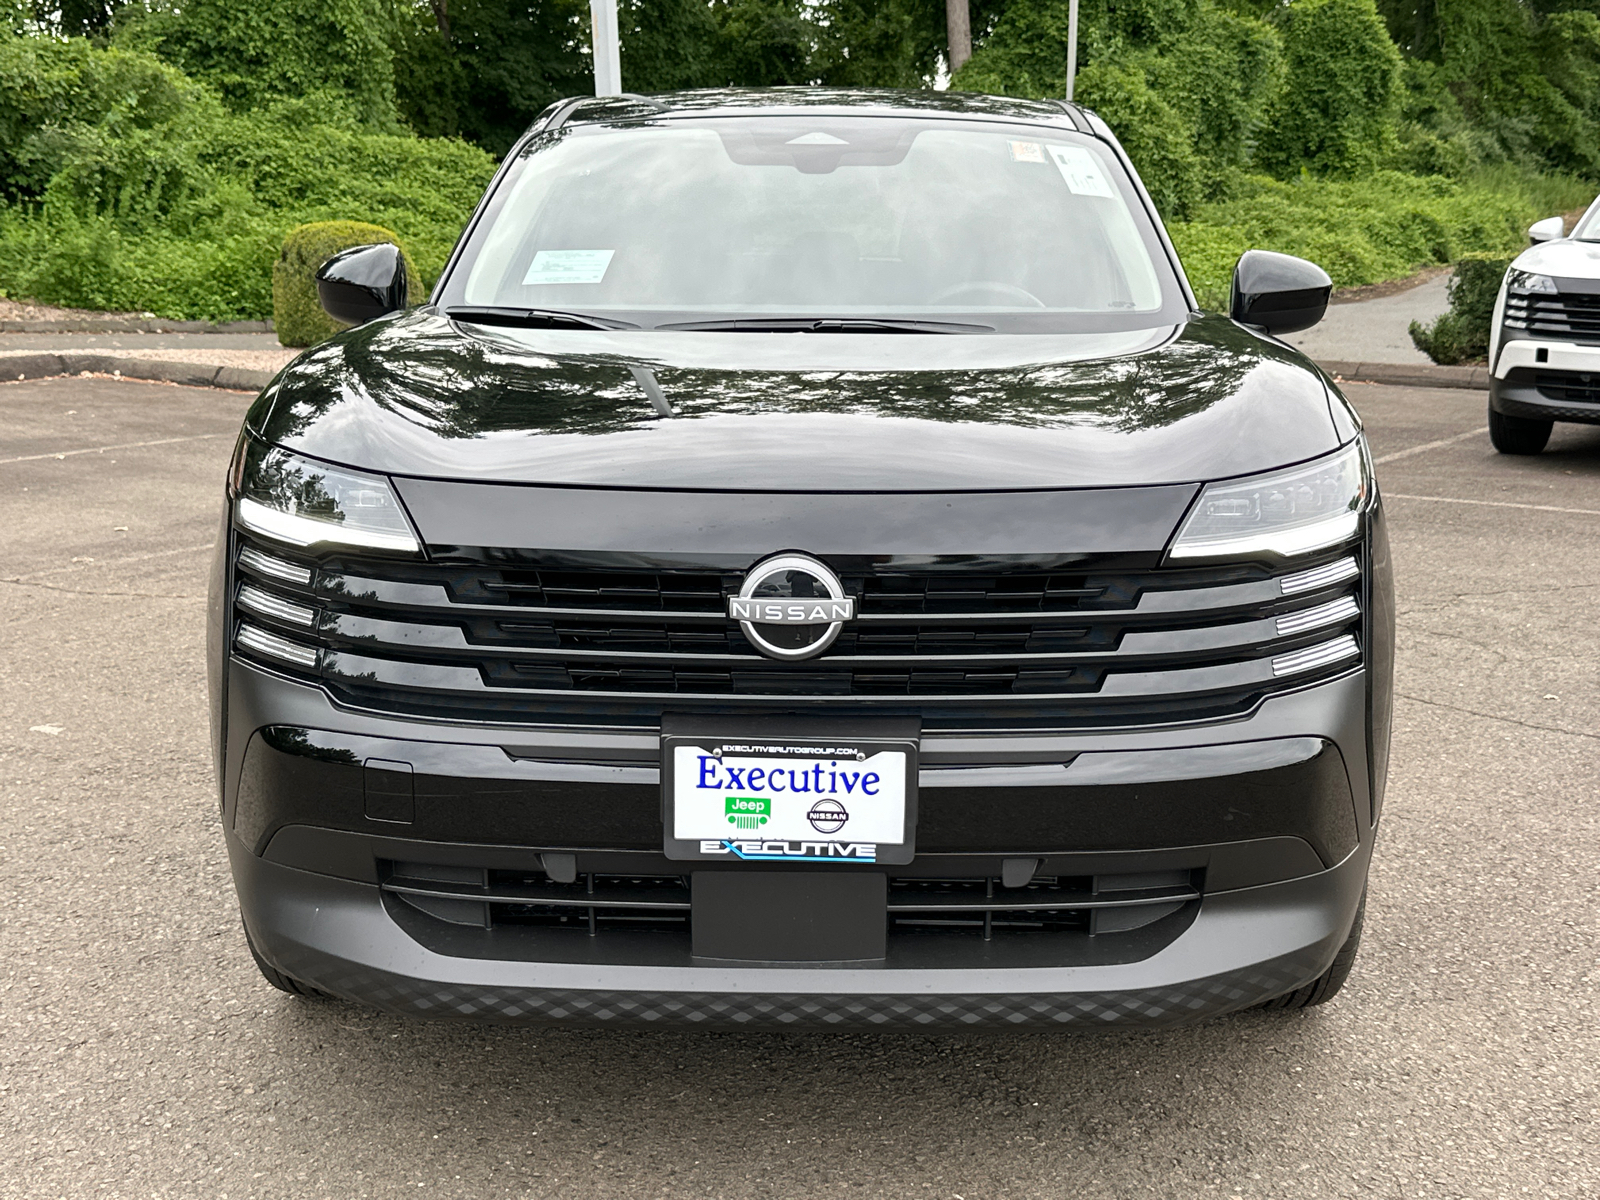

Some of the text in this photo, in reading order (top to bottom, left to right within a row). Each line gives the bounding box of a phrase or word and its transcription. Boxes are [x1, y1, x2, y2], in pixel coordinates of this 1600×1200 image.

[732, 602, 850, 620] NISSAN
[722, 745, 857, 755] EXECUTIVEAUTOGROUP.COM
[696, 755, 880, 796] Executive
[731, 799, 765, 812] Jeep
[809, 812, 847, 820] NISSAN
[700, 840, 877, 858] EXECUTIVE
